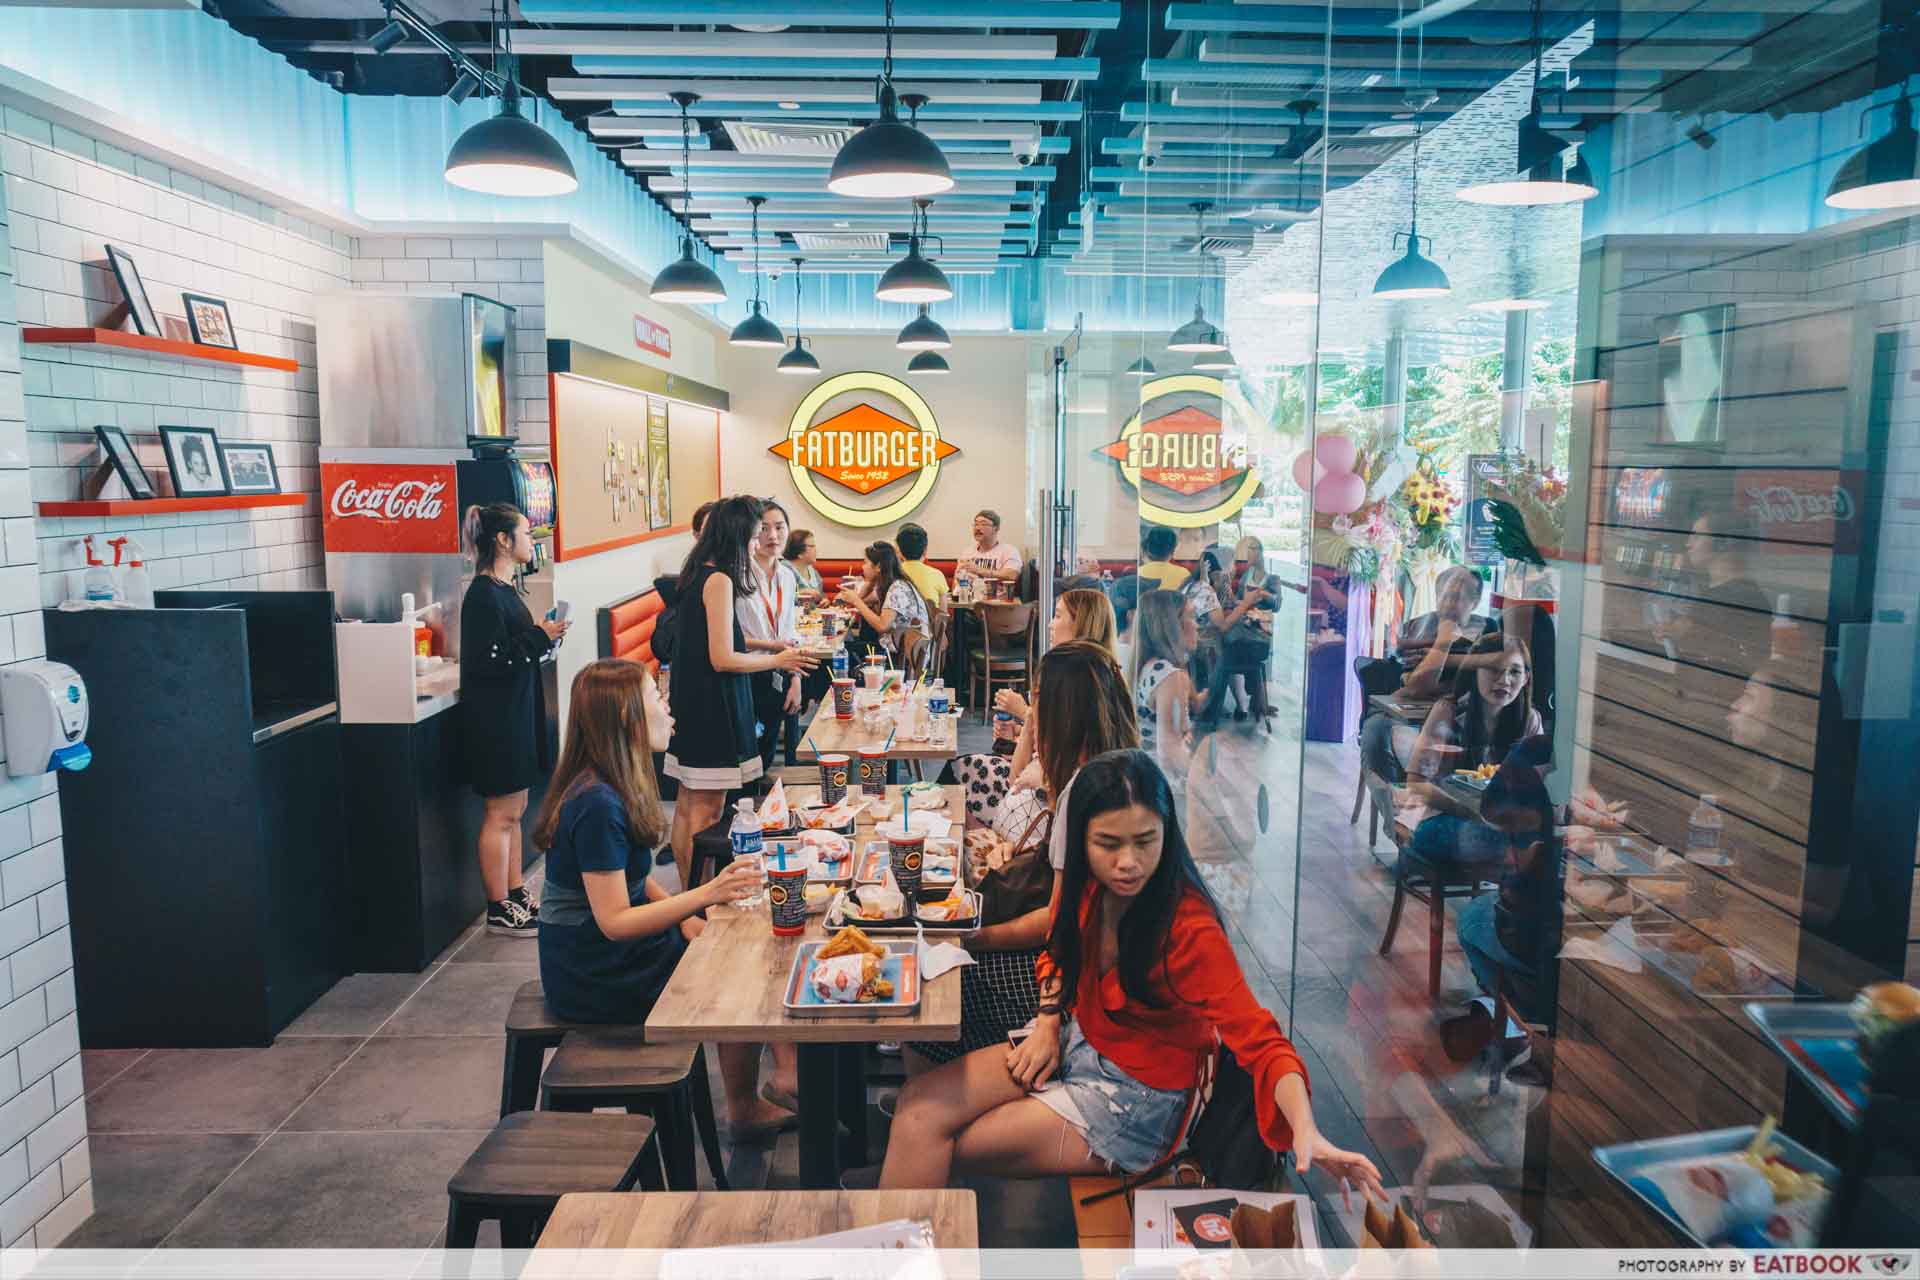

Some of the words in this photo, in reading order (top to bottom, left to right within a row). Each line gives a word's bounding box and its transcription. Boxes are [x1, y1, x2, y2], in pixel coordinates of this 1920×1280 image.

[792, 430, 937, 467] FATBURGER
[866, 471, 889, 480] 1952
[331, 479, 447, 519] Coca-Cola
